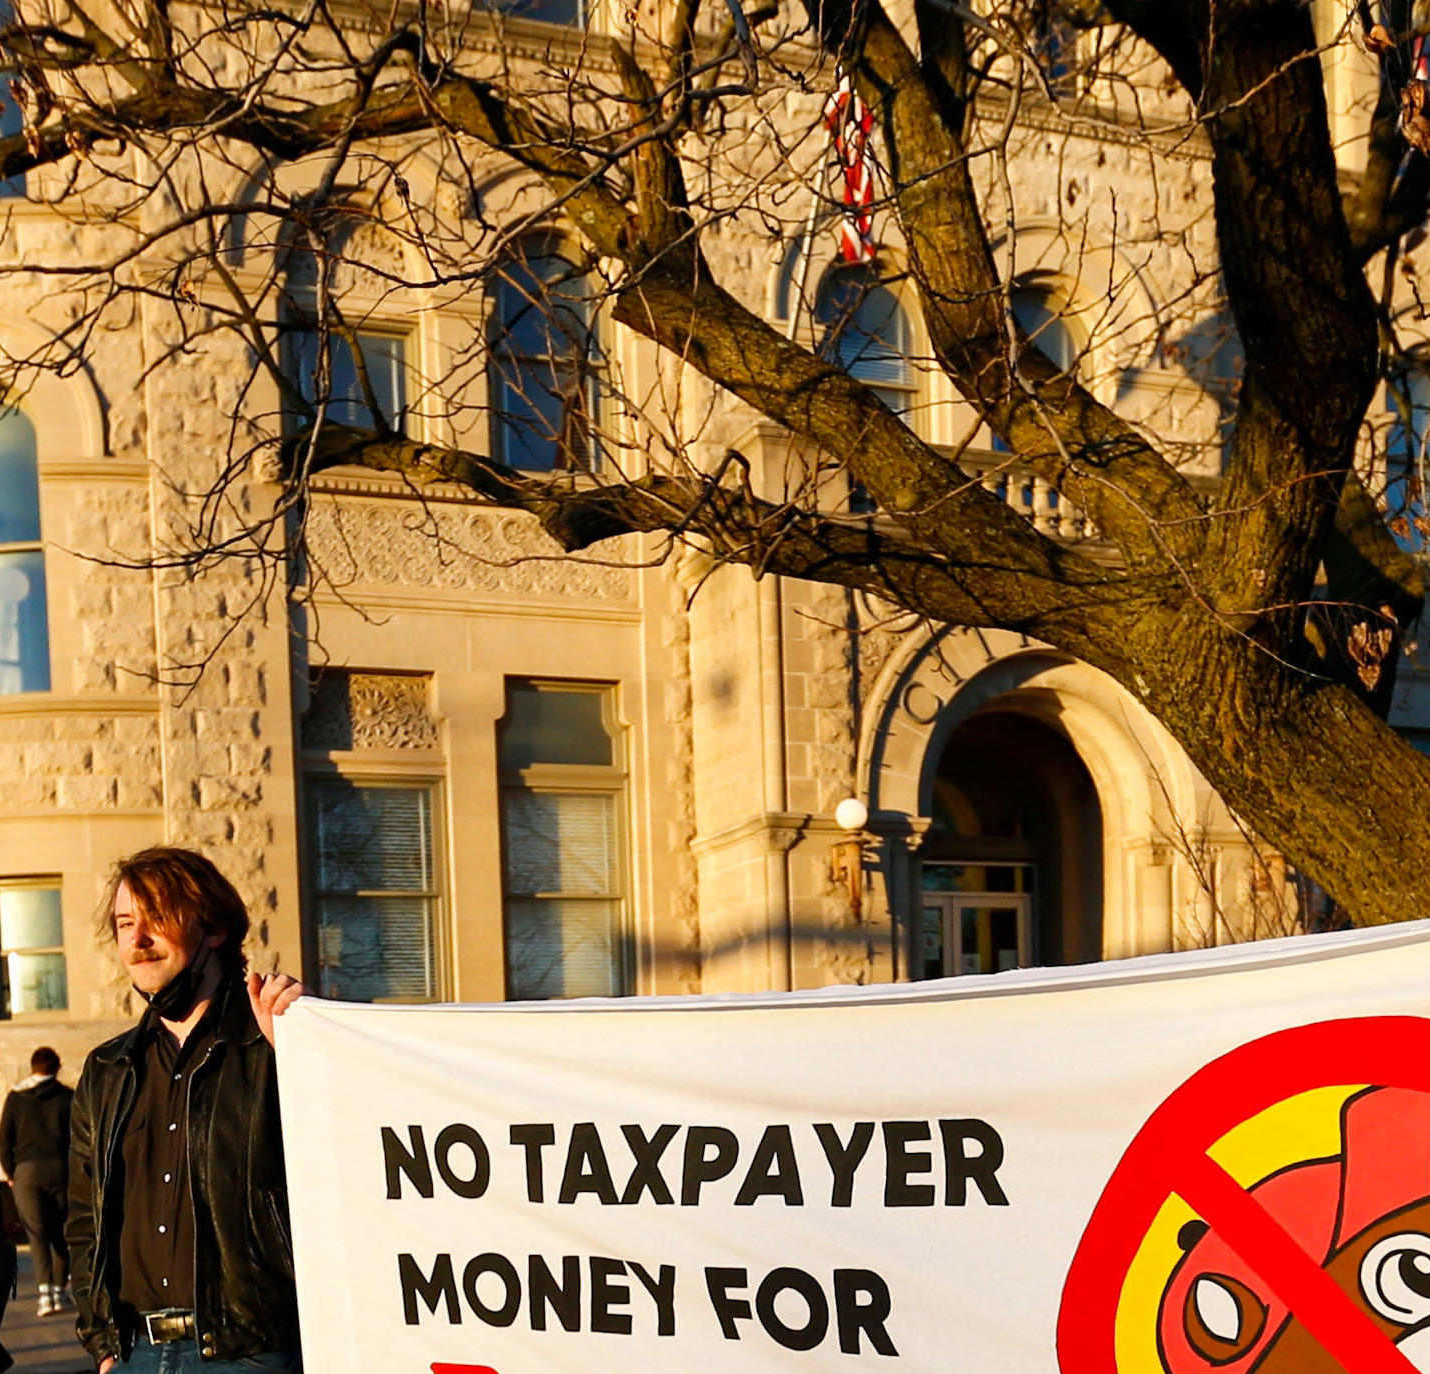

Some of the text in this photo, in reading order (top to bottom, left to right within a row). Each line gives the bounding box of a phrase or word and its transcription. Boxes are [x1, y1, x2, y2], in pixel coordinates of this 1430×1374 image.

[381, 1118, 1010, 1207] NO TAXPAYER
[397, 1252, 900, 1357] MONEY FOR
